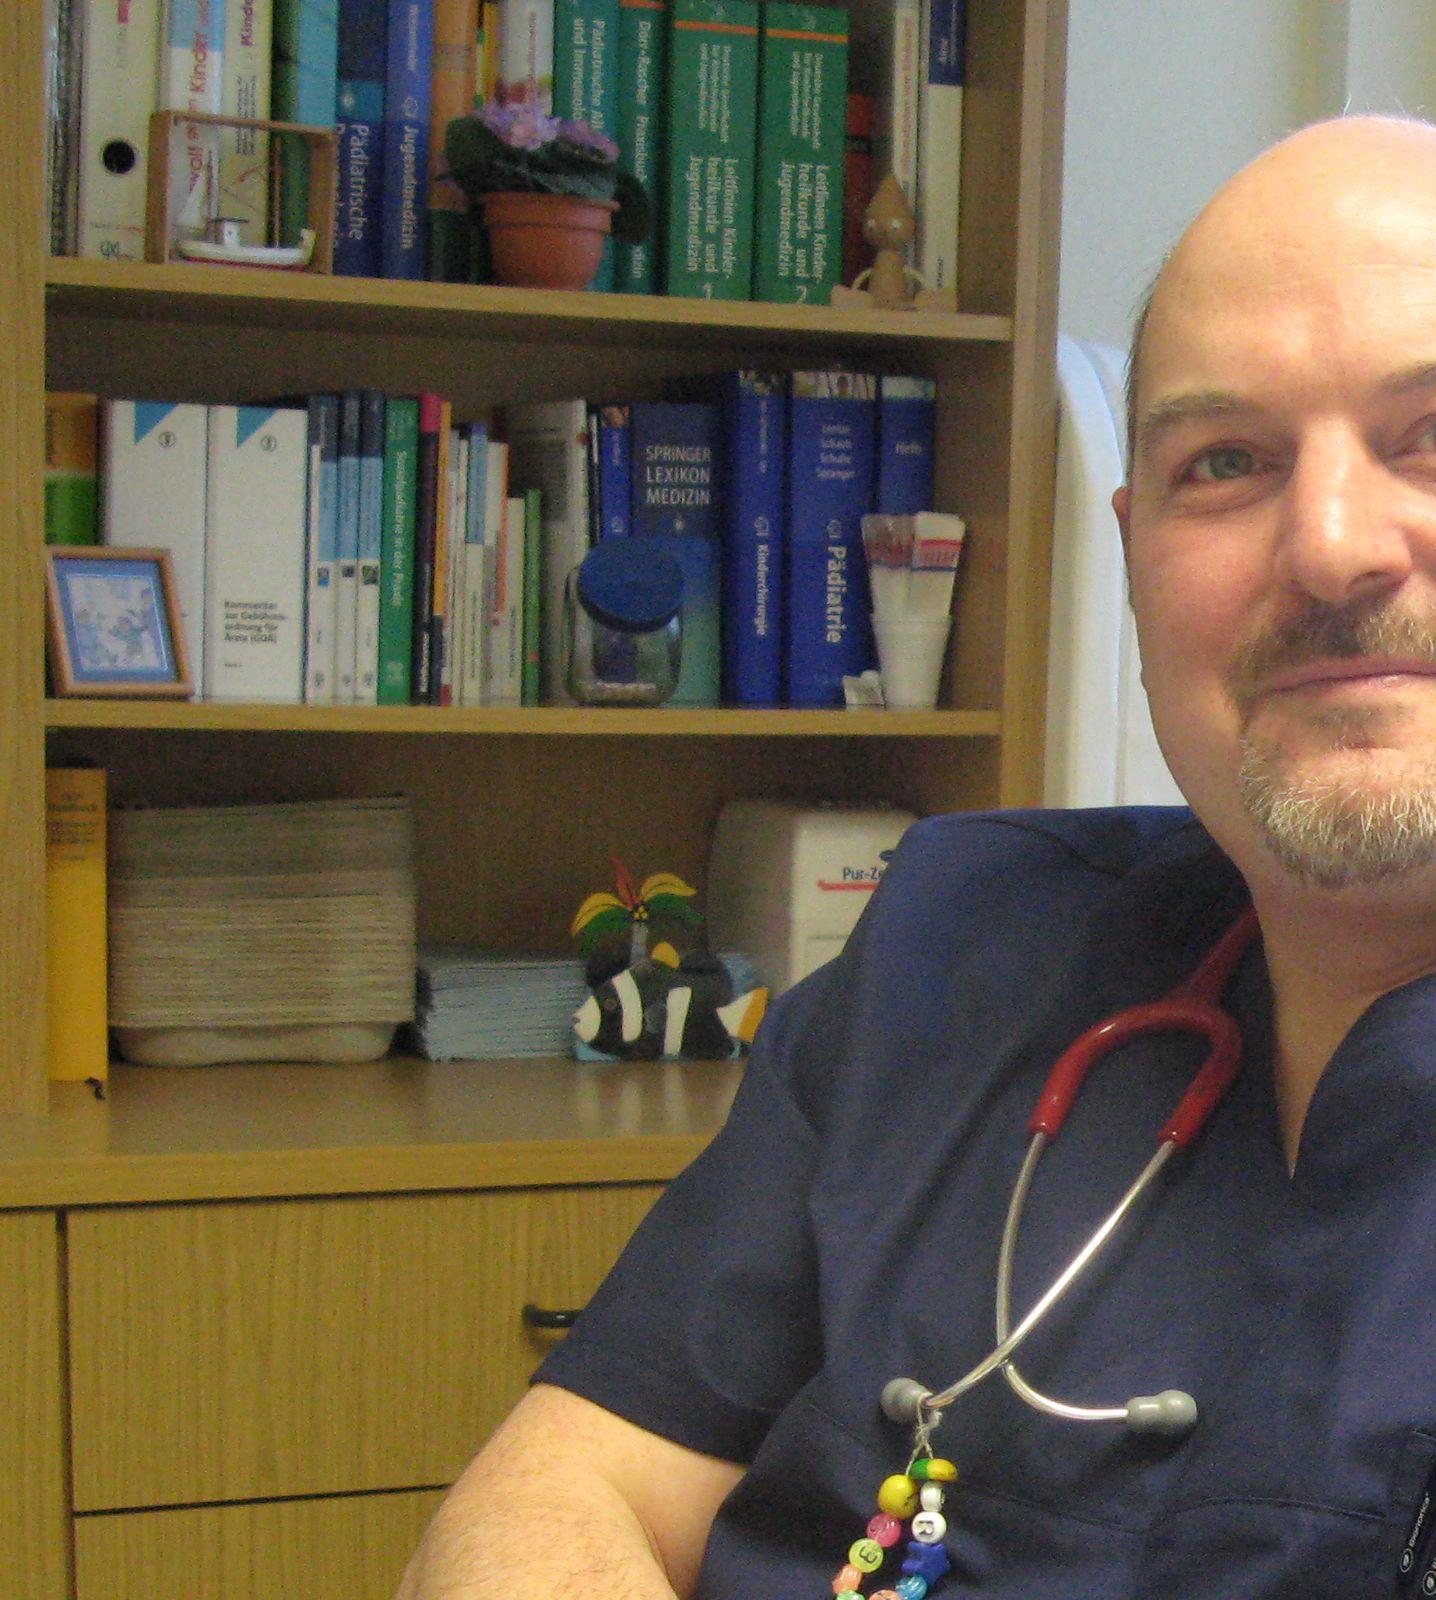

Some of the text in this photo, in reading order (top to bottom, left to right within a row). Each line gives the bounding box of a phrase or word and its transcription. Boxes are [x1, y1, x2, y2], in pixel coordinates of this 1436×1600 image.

[189, 32, 208, 93] Kinder
[572, 17, 586, 120] und Immunolo
[348, 123, 370, 240] Pädiatrische
[400, 125, 419, 249] Jugendmedizin
[685, 155, 704, 271] Jugendmedizin
[704, 157, 722, 273] heilkunde und
[723, 158, 739, 223] Leitlinien
[777, 162, 795, 276] Jugendmedizin
[796, 163, 813, 277] heilkunde und
[813, 165, 831, 229] Leitlinien
[702, 283, 713, 299] 1
[795, 286, 809, 304] 2
[645, 444, 712, 463] SPRINGER
[645, 466, 711, 485] LEXIKON
[645, 488, 711, 507] MEDIZIN
[754, 544, 770, 636] Kinderchirurgie
[826, 545, 847, 644] Pädiatrie
